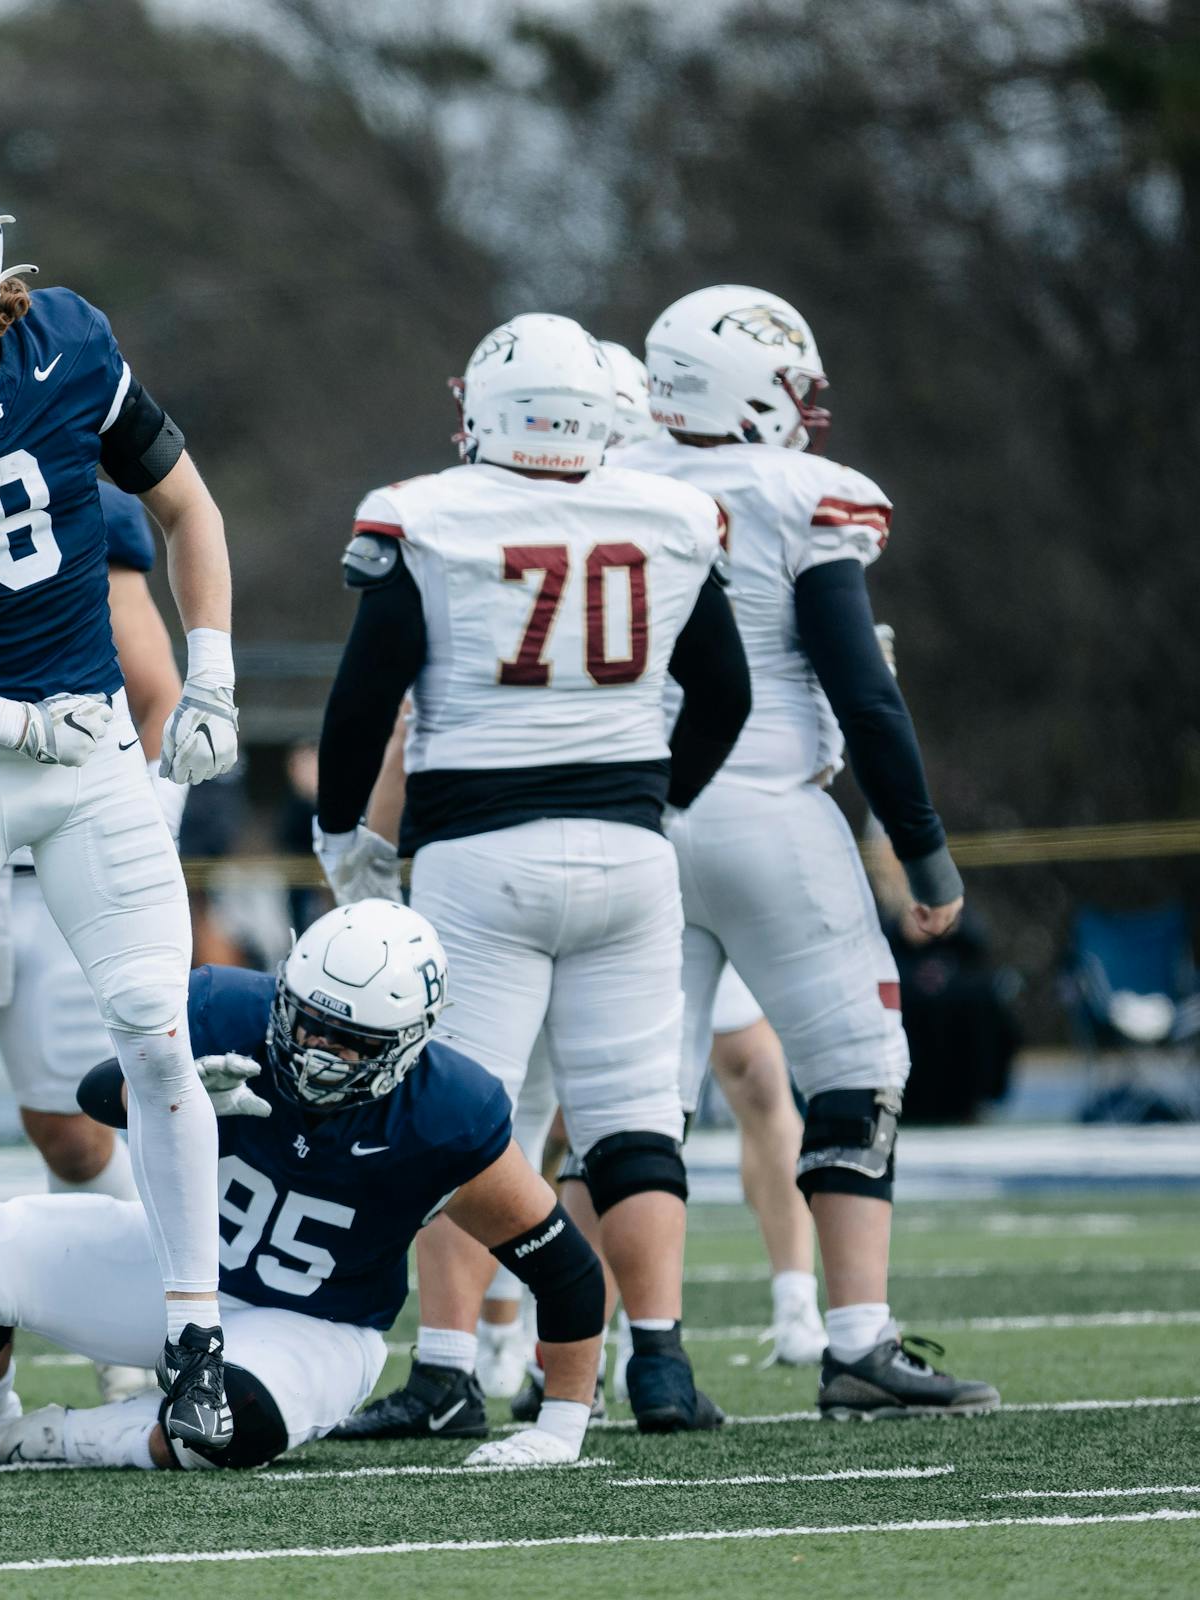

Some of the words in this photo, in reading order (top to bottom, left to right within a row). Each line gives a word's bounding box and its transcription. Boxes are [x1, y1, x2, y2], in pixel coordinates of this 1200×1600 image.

[563, 419, 580, 435] 70
[512, 450, 585, 468] Riddell
[497, 540, 651, 688] 70
[292, 1134, 310, 1158] BU
[218, 1154, 357, 1297] 95
